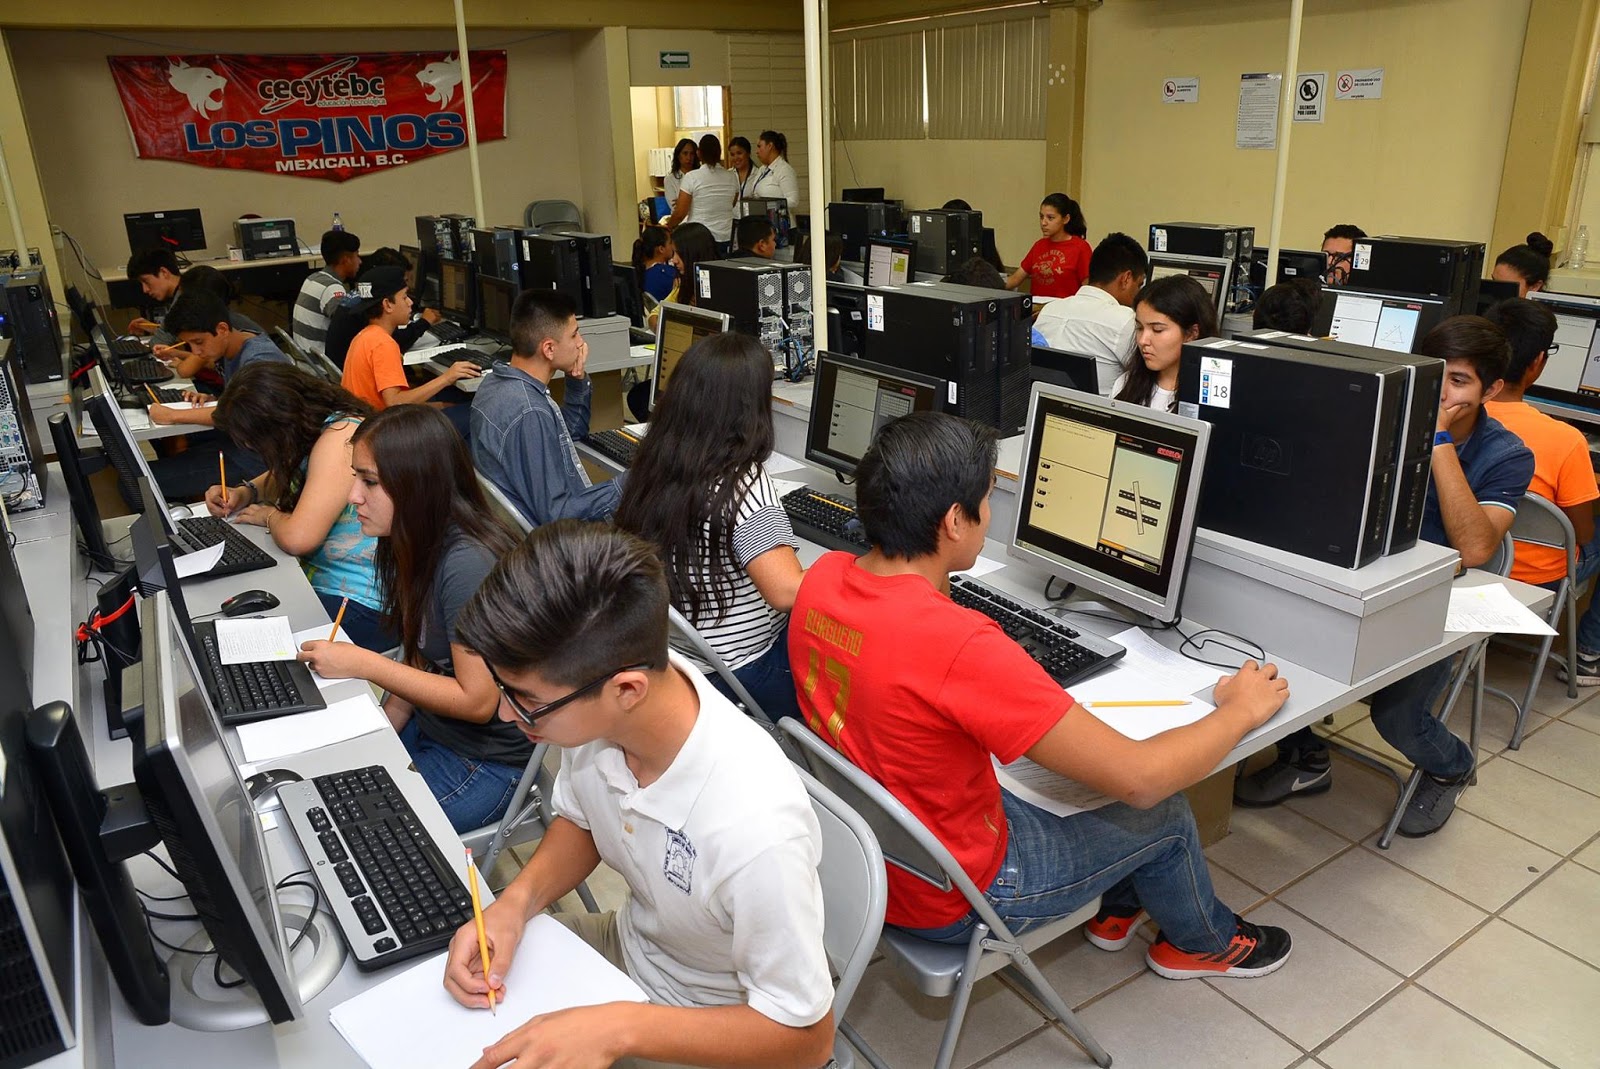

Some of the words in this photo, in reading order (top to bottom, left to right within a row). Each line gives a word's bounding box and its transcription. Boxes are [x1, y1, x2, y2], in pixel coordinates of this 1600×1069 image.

[184, 120, 278, 152] LOS
[277, 112, 466, 157] PINOS
[275, 156, 371, 172] MEXICALI,
[375, 154, 408, 166] B.C.
[1360, 257, 1369, 266] 29
[874, 314, 883, 324] 17
[1213, 385, 1228, 399] 18
[804, 646, 851, 756] 17
